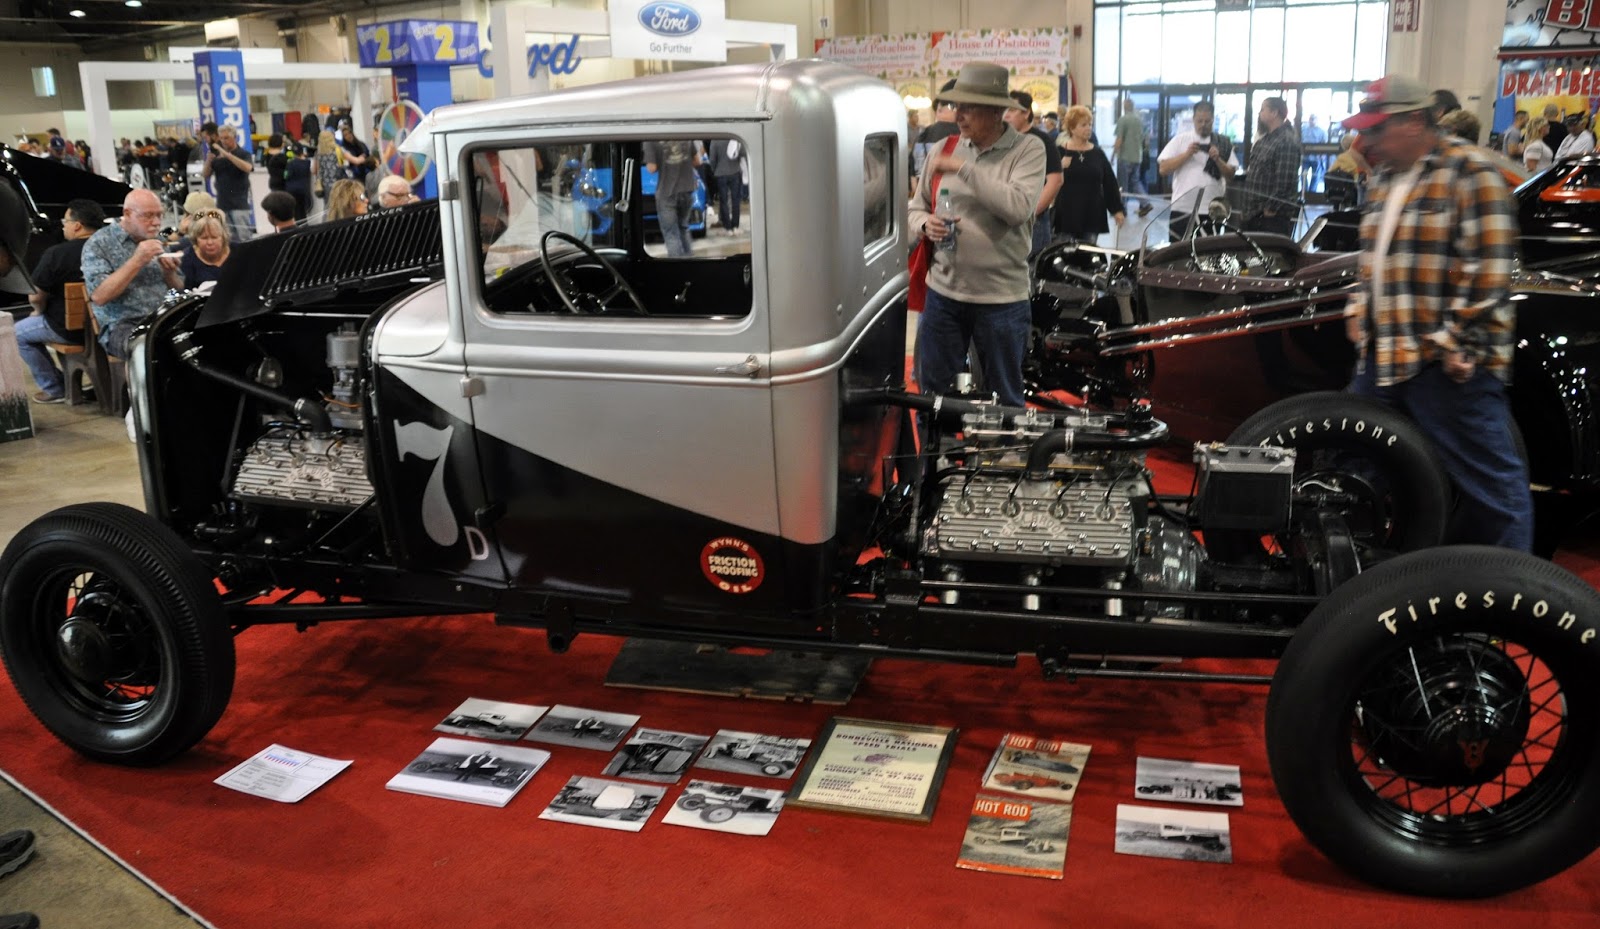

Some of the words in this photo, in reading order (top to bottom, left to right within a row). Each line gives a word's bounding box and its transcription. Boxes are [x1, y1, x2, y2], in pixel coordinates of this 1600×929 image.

[651, 4, 691, 32] Ford
[1394, 14, 1411, 25] HOE
[375, 26, 392, 63] 2
[435, 24, 456, 61] 2
[650, 42, 662, 53] Go
[663, 43, 692, 54] Further
[949, 40, 981, 50] House
[984, 39, 994, 48] of
[997, 38, 1050, 49] Pistachios
[1501, 68, 1565, 98] DRAFT
[355, 206, 404, 222] DENVER
[1259, 417, 1398, 449] Firestone
[393, 418, 459, 546] 7
[464, 526, 489, 561] D
[709, 537, 750, 553] WYNN'S
[708, 555, 757, 569] FRICTION
[710, 564, 759, 578] PROOFING
[718, 581, 753, 593] OIL
[1377, 590, 1597, 644] Firestone
[1008, 735, 1034, 748] HOT
[1035, 738, 1060, 752] ROD
[975, 800, 1001, 814] HOT
[1003, 804, 1029, 817] ROD
